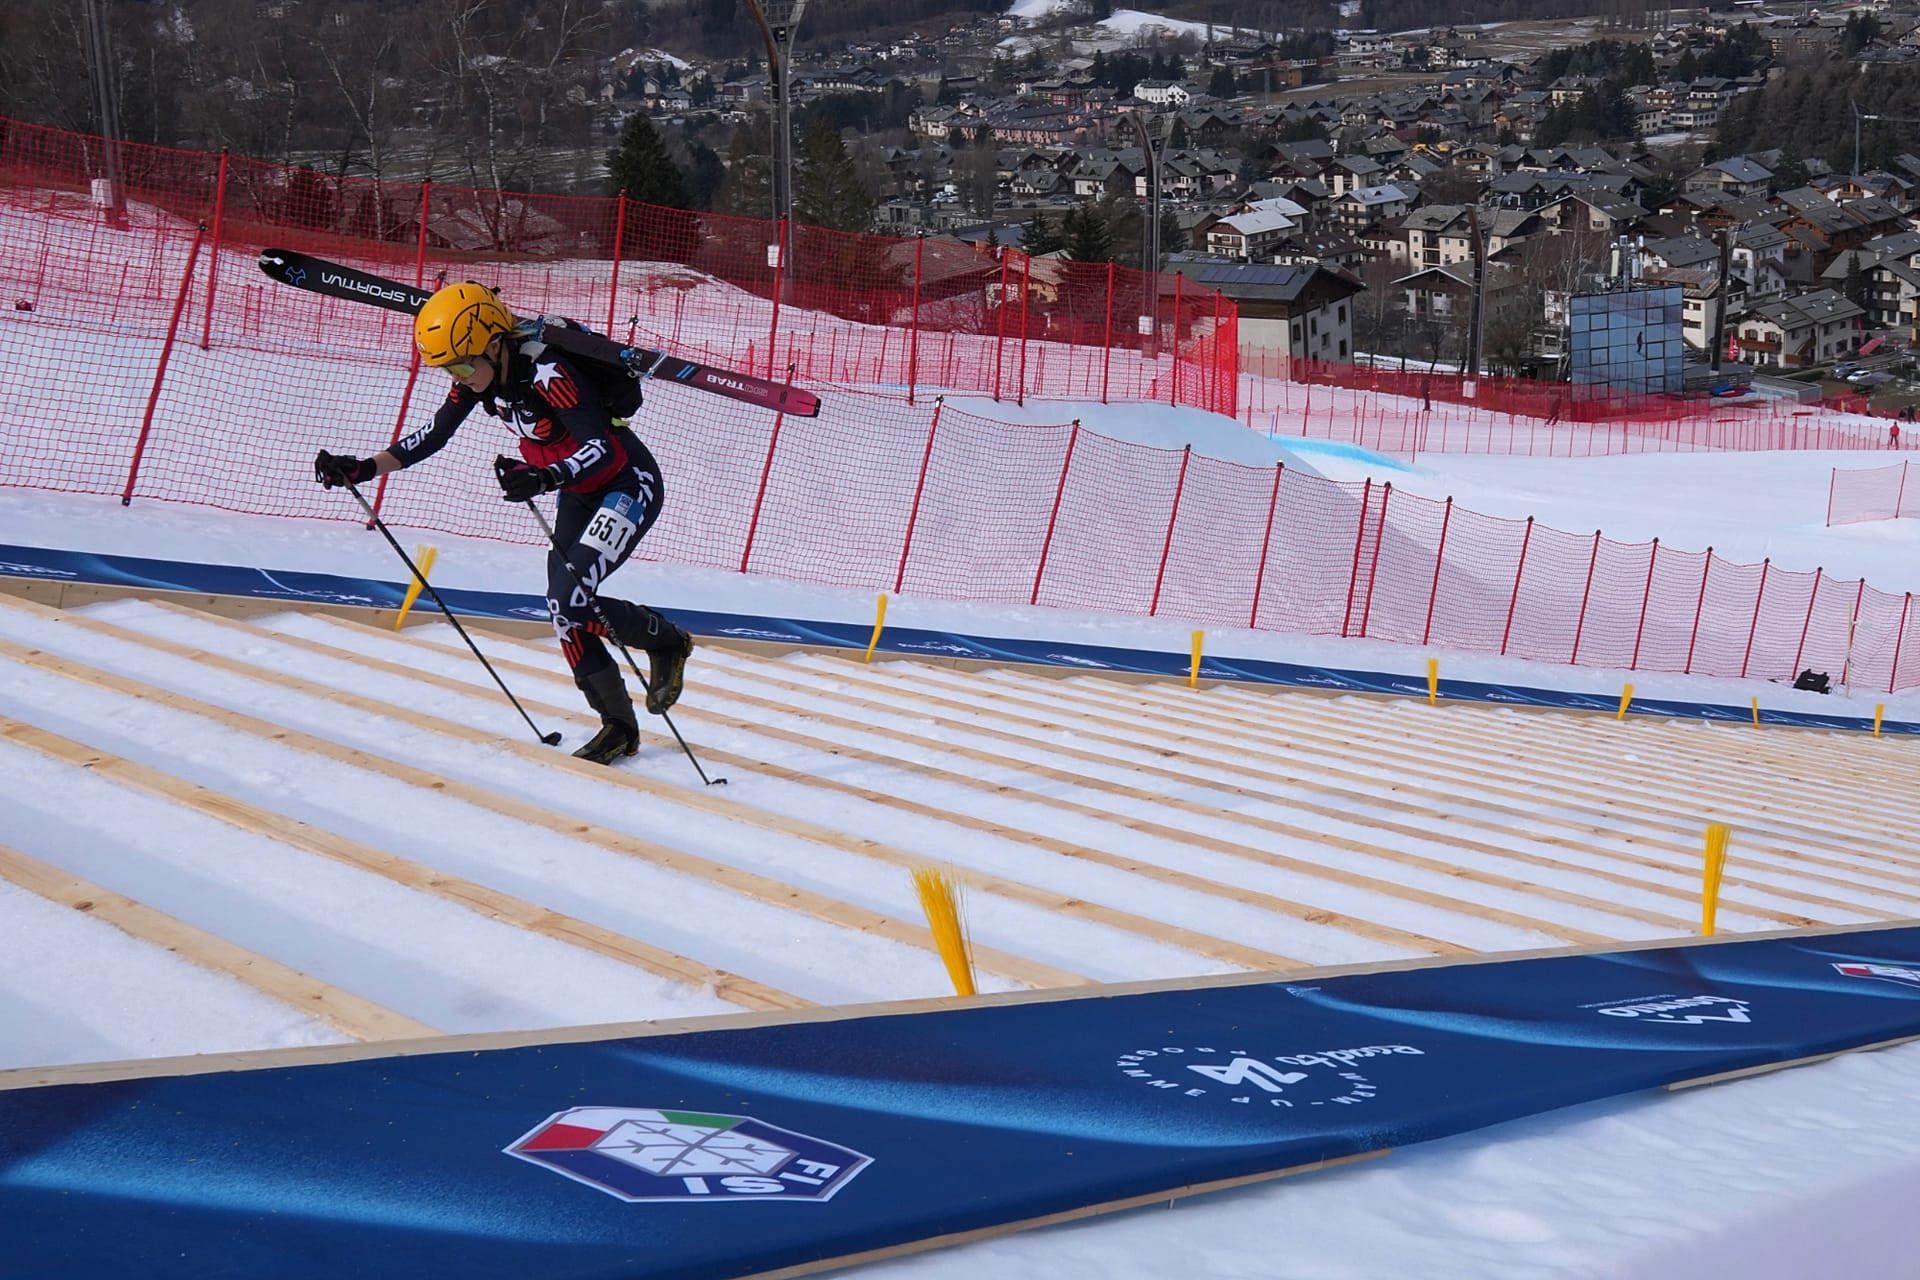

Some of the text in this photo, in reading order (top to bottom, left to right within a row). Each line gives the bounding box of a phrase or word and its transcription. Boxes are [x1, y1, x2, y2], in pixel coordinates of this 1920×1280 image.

[321, 271, 406, 303] SPORTIVA
[706, 374, 745, 391] TRAB
[588, 514, 629, 551] 55.1
[682, 1158, 840, 1195] FISI
